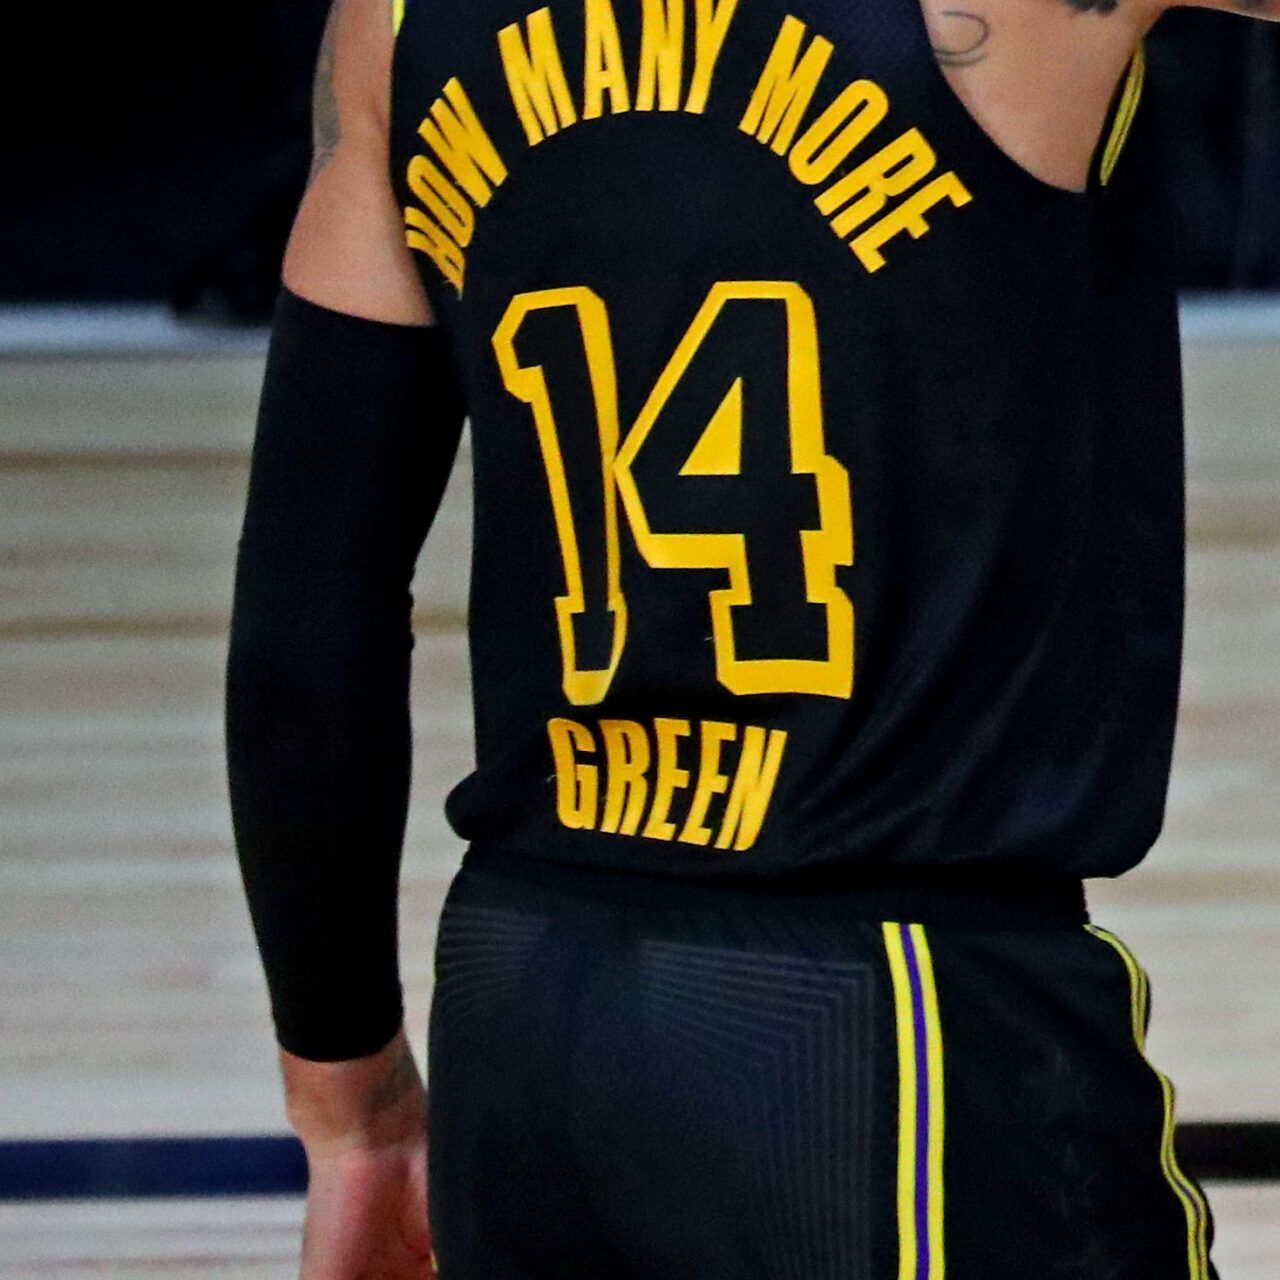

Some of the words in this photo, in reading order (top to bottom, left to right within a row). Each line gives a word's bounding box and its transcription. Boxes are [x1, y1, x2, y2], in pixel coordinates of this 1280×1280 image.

[738, 14, 973, 274] MORE
[491, 280, 855, 706] 14
[547, 717, 788, 852] GREEN
